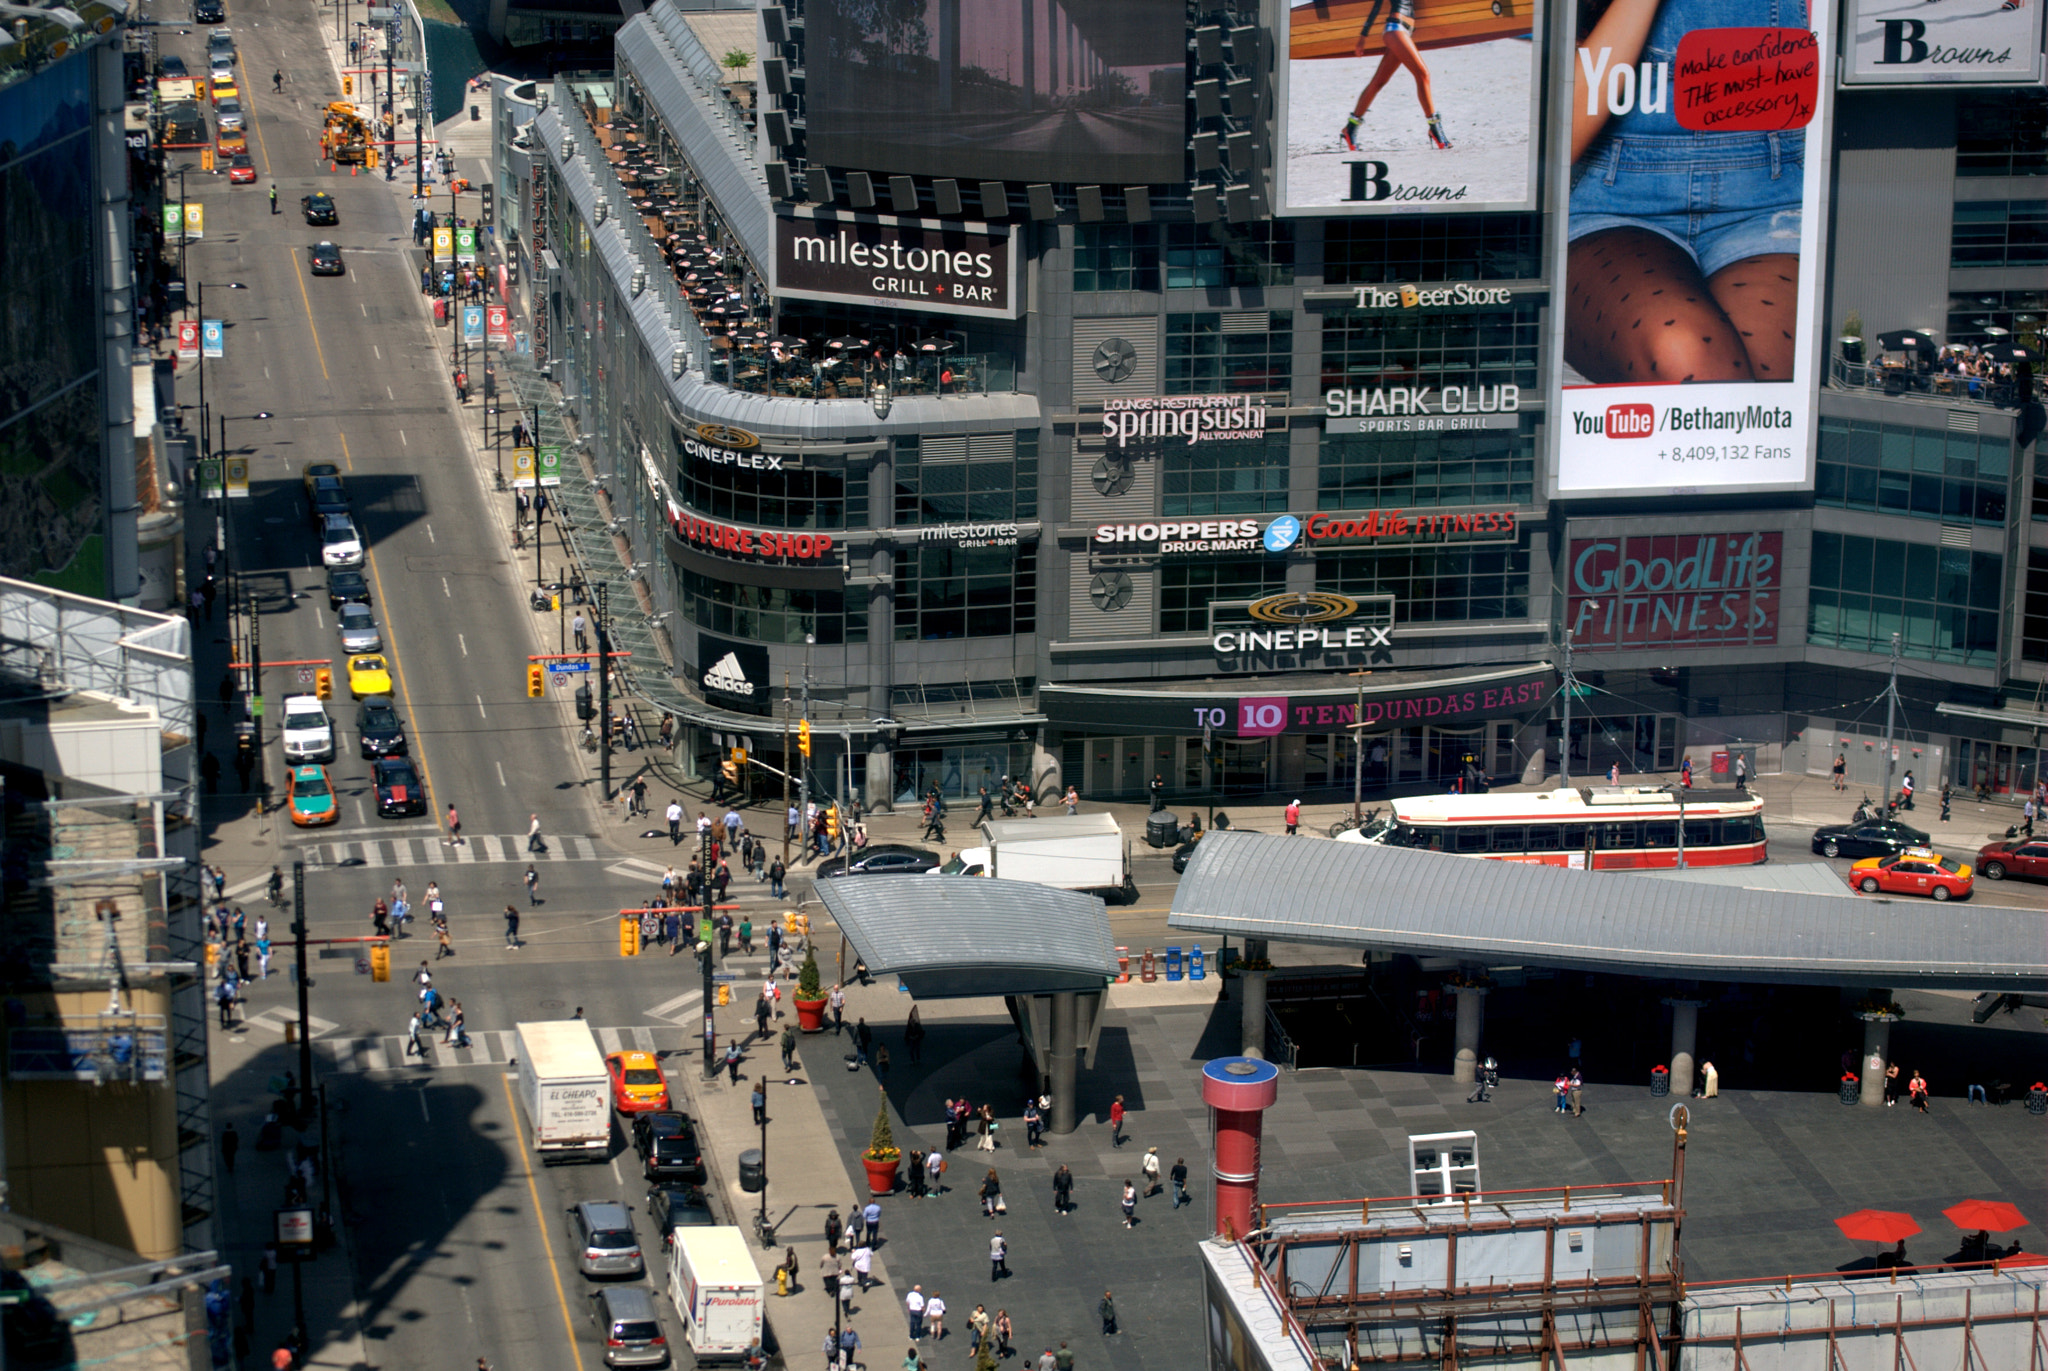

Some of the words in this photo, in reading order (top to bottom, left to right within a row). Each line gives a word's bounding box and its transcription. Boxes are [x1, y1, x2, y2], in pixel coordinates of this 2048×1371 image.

[1681, 47, 1727, 77] Make
[1733, 31, 1819, 65] confidence
[1874, 19, 2011, 64] Browns
[1578, 47, 1668, 116] You
[1683, 81, 1719, 108] THE
[1724, 61, 1814, 97] must-have
[1703, 92, 1800, 127] accessory
[1341, 161, 1467, 202] Browns
[484, 191, 492, 221] HMV
[533, 163, 544, 272] FUTURE
[509, 250, 517, 281] HMV
[794, 230, 993, 278] milestones
[872, 276, 929, 295] GRILL
[953, 284, 992, 301] BAR
[1354, 286, 1398, 308] The
[1400, 284, 1453, 308] Beer
[1454, 283, 1511, 305] Store
[534, 291, 545, 362] SHOP
[1104, 398, 1153, 411] LOUNGE
[1160, 395, 1241, 409] RESTAURANT
[1326, 387, 1430, 416] SHARK
[1442, 384, 1520, 413] CLUB
[1359, 420, 1411, 432] SPORTS
[1418, 419, 1444, 431] BAR
[1451, 418, 1488, 429] GRILL
[684, 440, 783, 471] CINEPLEX
[1672, 446, 1749, 463] 8,409,132
[1755, 446, 1791, 459] Fans
[678, 514, 754, 555] FUTURE
[759, 532, 832, 558] SHOP
[921, 523, 1018, 540] milestones
[1096, 520, 1258, 543] SHOPPERS
[1307, 510, 1408, 539] GoodLife
[1416, 511, 1515, 535] FITNESS
[959, 539, 988, 548] GRILL
[997, 537, 1018, 546] BAR
[1161, 542, 1210, 553] DRUG
[1214, 539, 1258, 552] MART
[1574, 535, 1774, 594] GoodLife
[1575, 592, 1770, 636] FITNESS
[1213, 626, 1392, 653] CINEPLEX
[704, 674, 754, 695] adidas
[1194, 708, 1226, 727] TO
[1295, 704, 1356, 725] TEN
[1364, 691, 1476, 722] DUNDAS
[1483, 681, 1545, 709] EAST
[562, 1089, 597, 1099] CHEAPO
[711, 1297, 760, 1306] Purolator
